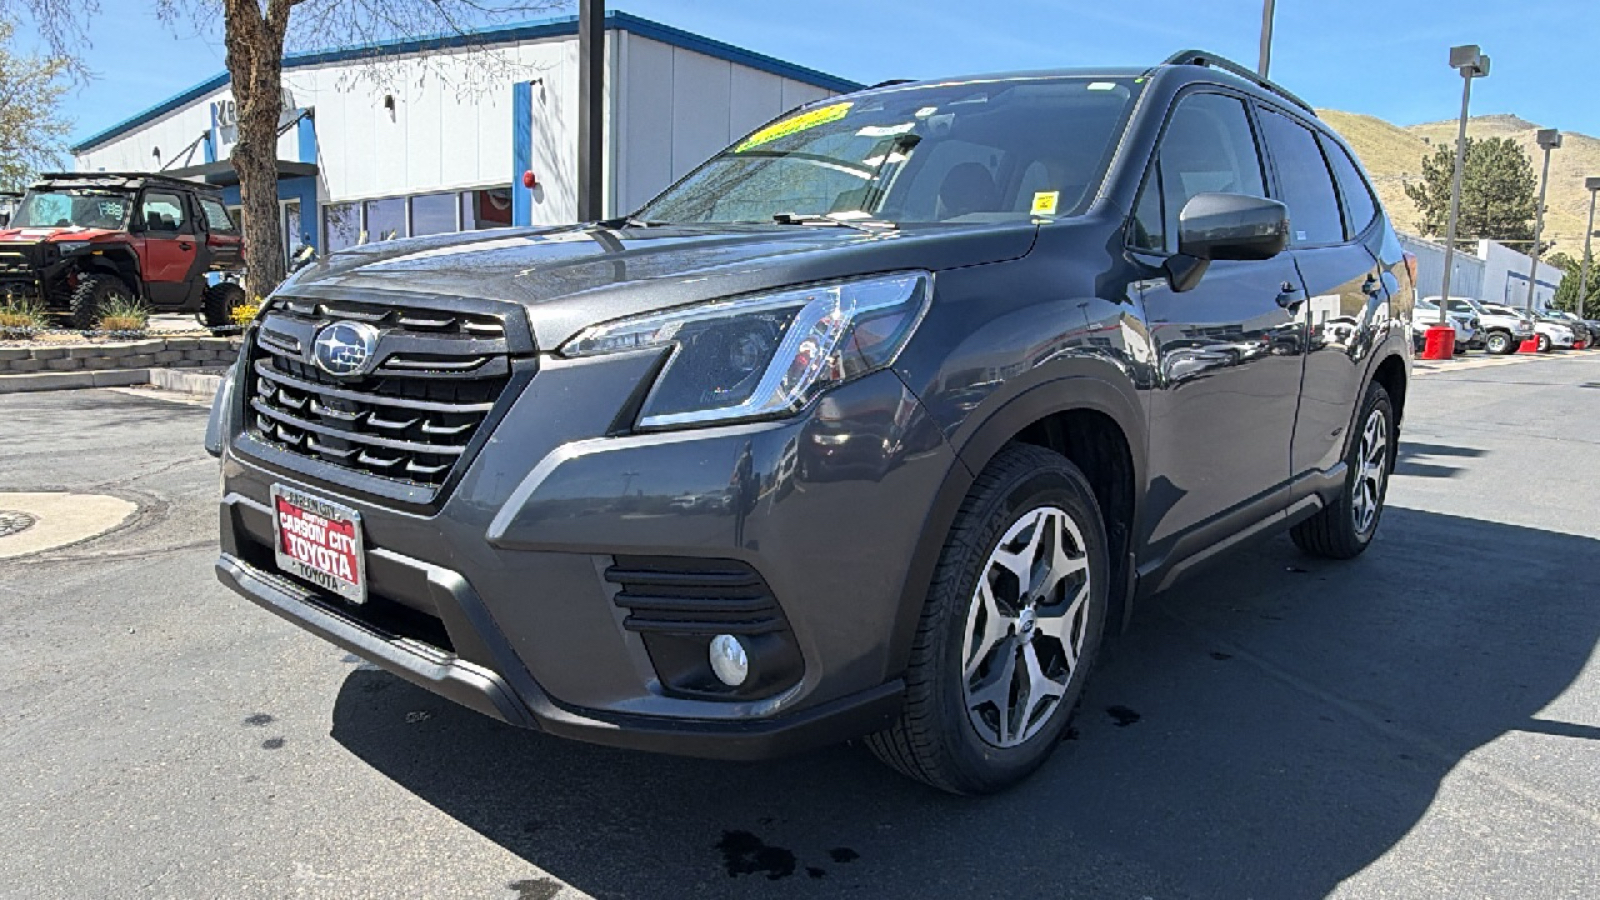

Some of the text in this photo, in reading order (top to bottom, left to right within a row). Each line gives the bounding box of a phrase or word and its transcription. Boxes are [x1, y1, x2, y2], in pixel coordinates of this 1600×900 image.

[280, 512, 356, 555] CARSON CITY
[287, 532, 354, 581] TOYOTA
[299, 563, 338, 591] TOYOTA
